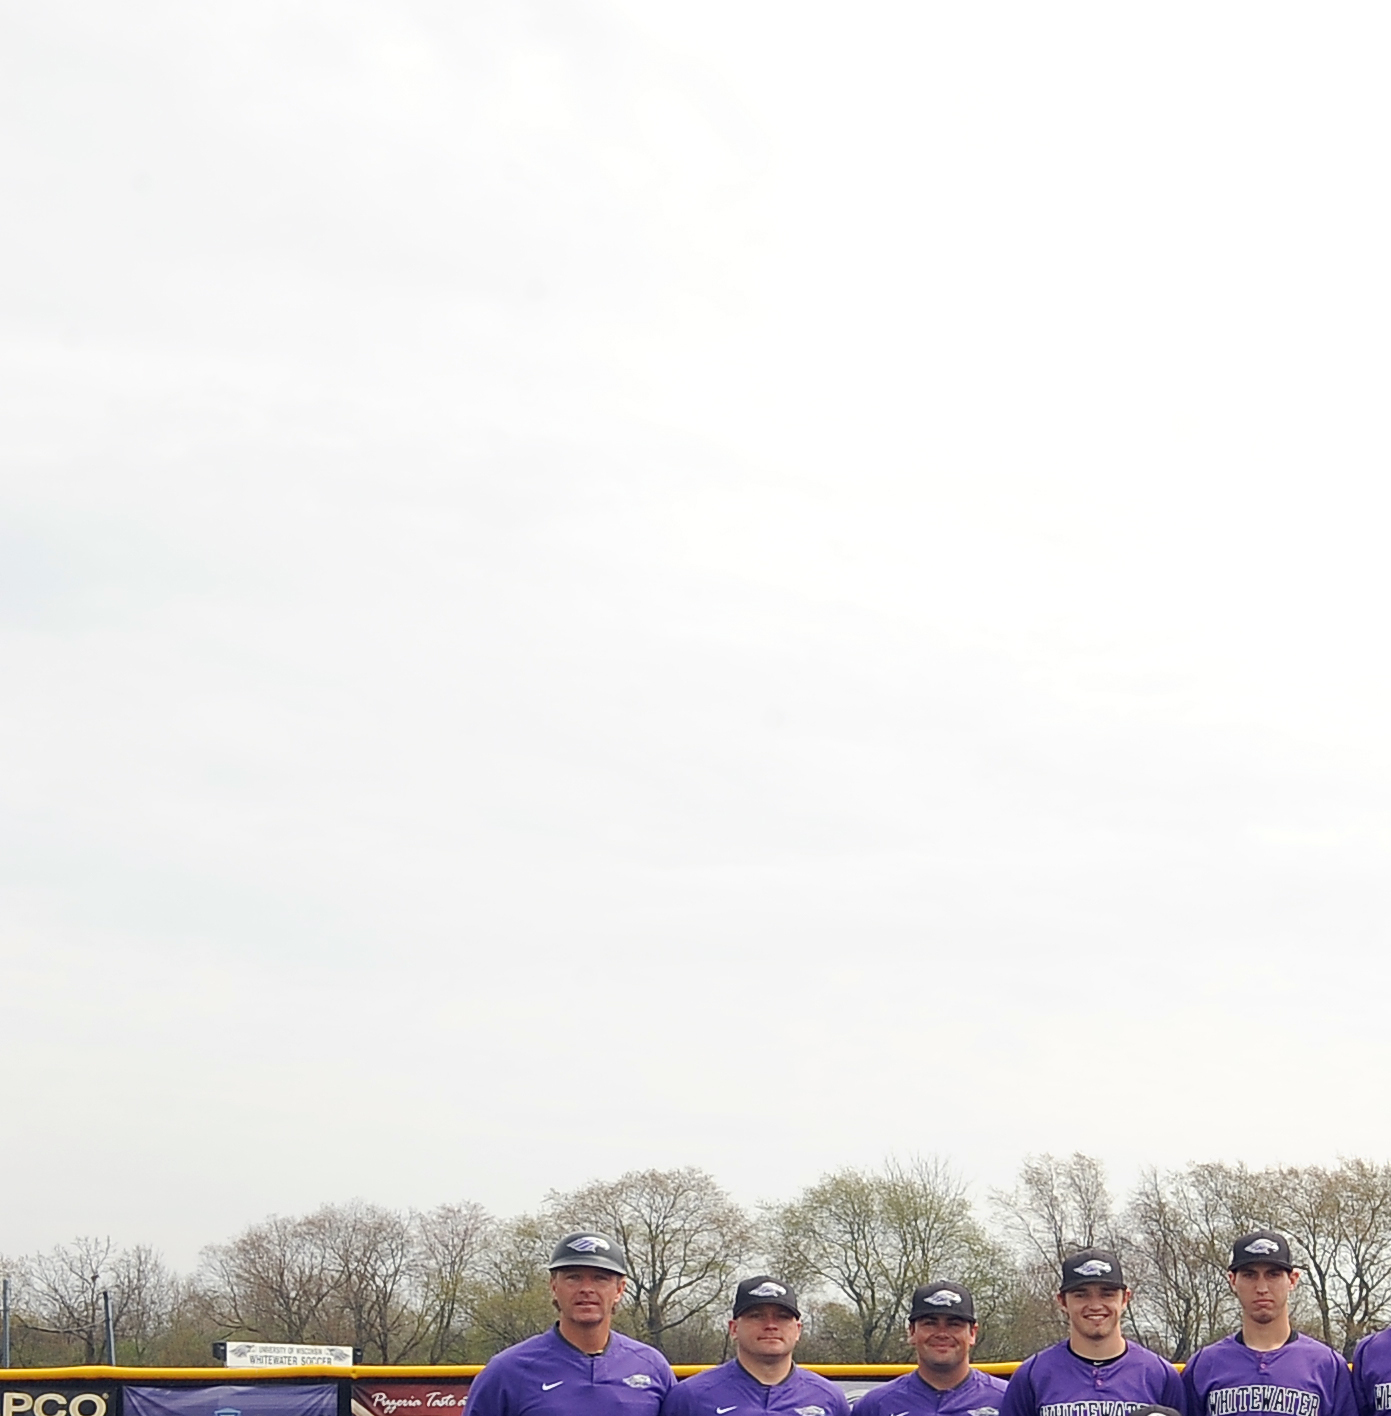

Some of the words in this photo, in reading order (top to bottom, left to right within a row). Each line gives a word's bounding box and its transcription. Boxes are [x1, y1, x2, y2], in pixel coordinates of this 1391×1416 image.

[250, 1354, 297, 1365] WHITEWATER
[301, 1355, 332, 1366] SOCCER
[372, 1392, 422, 1414] Pizzeria
